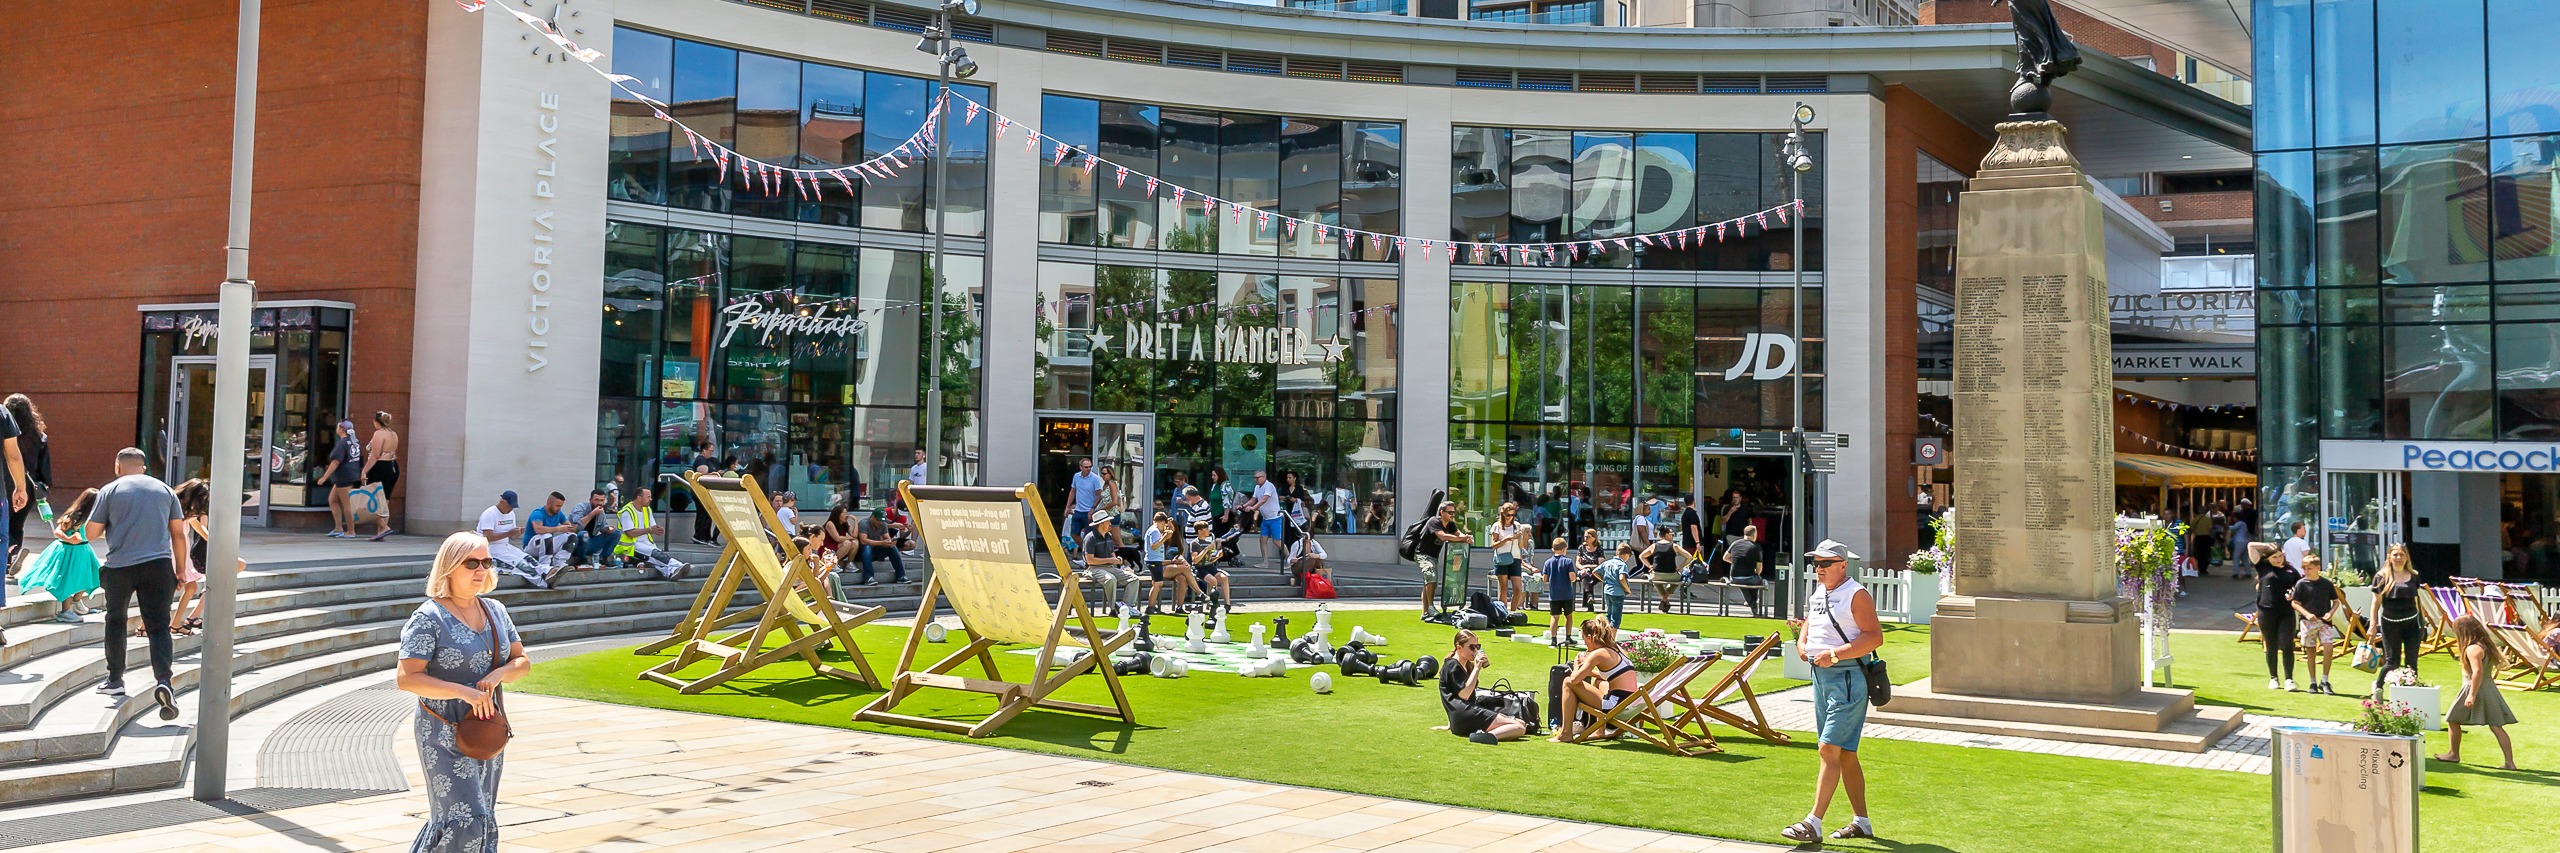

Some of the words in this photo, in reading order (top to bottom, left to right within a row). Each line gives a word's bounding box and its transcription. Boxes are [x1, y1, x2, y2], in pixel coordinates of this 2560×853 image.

[536, 91, 559, 198] PLACE
[1561, 144, 1695, 235] JD
[527, 210, 554, 373] VICTORIA
[2108, 293, 2254, 313] VICTORIA
[719, 297, 869, 349] Paperchase
[1125, 320, 1182, 360] PRET
[1190, 323, 1205, 361] A
[1214, 317, 1308, 365] MANGER
[2129, 314, 2228, 332] PLACE
[1724, 333, 1796, 381] JD
[2112, 356, 2182, 368] MARKET
[2189, 356, 2243, 368] WALK
[1631, 465, 1670, 473] RAINERS
[2358, 747, 2369, 790] Recycling
[2371, 748, 2380, 775] Mixed
